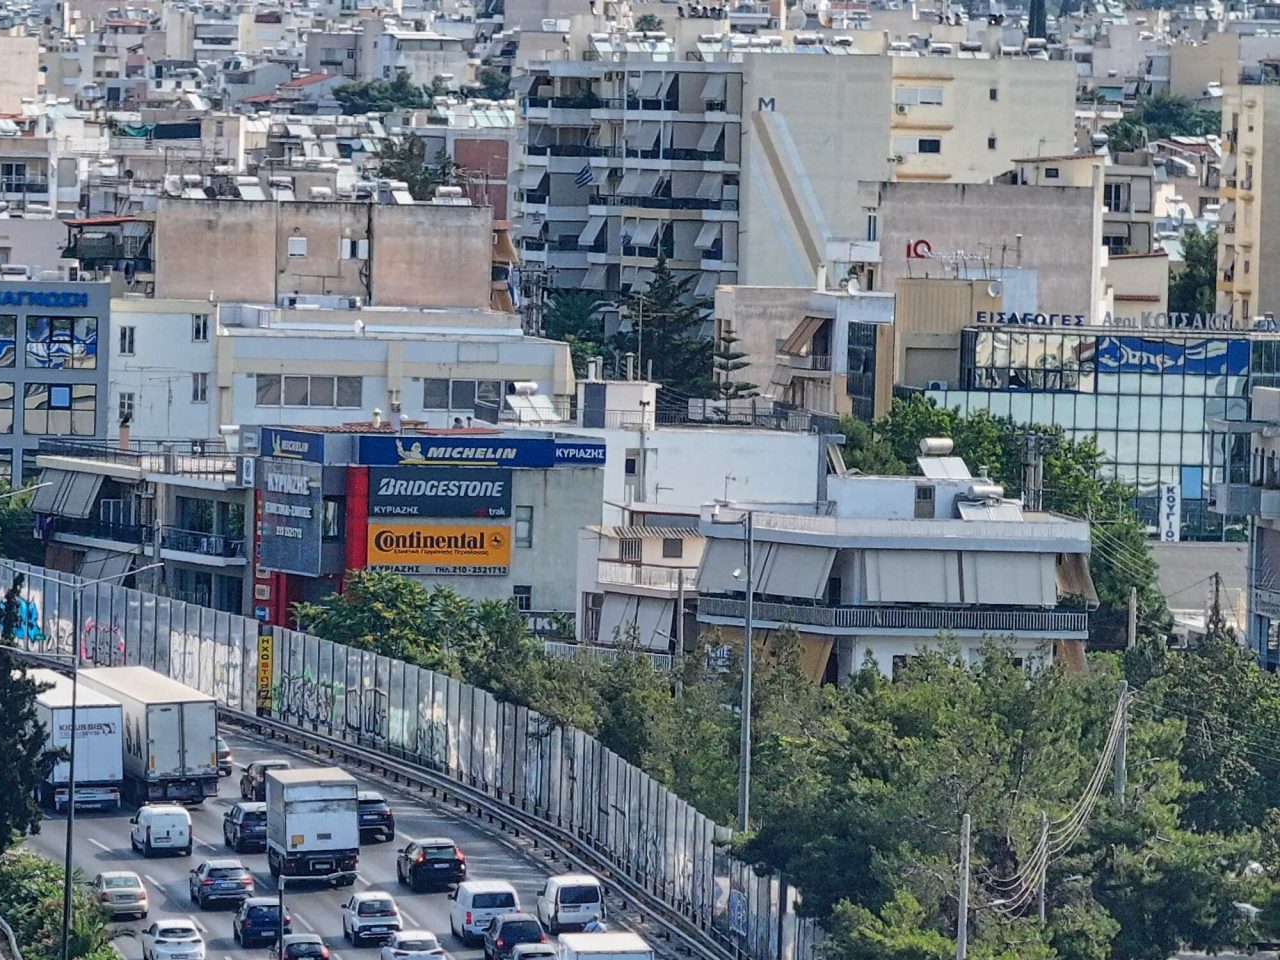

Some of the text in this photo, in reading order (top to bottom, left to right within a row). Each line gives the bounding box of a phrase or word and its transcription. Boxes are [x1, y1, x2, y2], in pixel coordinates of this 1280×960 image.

[427, 446, 517, 459] MICHELIN
[556, 448, 605, 459] ΚΥΡΙΑΖΗΣ
[378, 477, 504, 497] BRIDGESTONE
[374, 506, 419, 514] ΚΥΡΙΑΖΗΣ
[375, 530, 485, 552] Continental
[371, 565, 420, 573] ΚΥΡΙΑΖΗΣ
